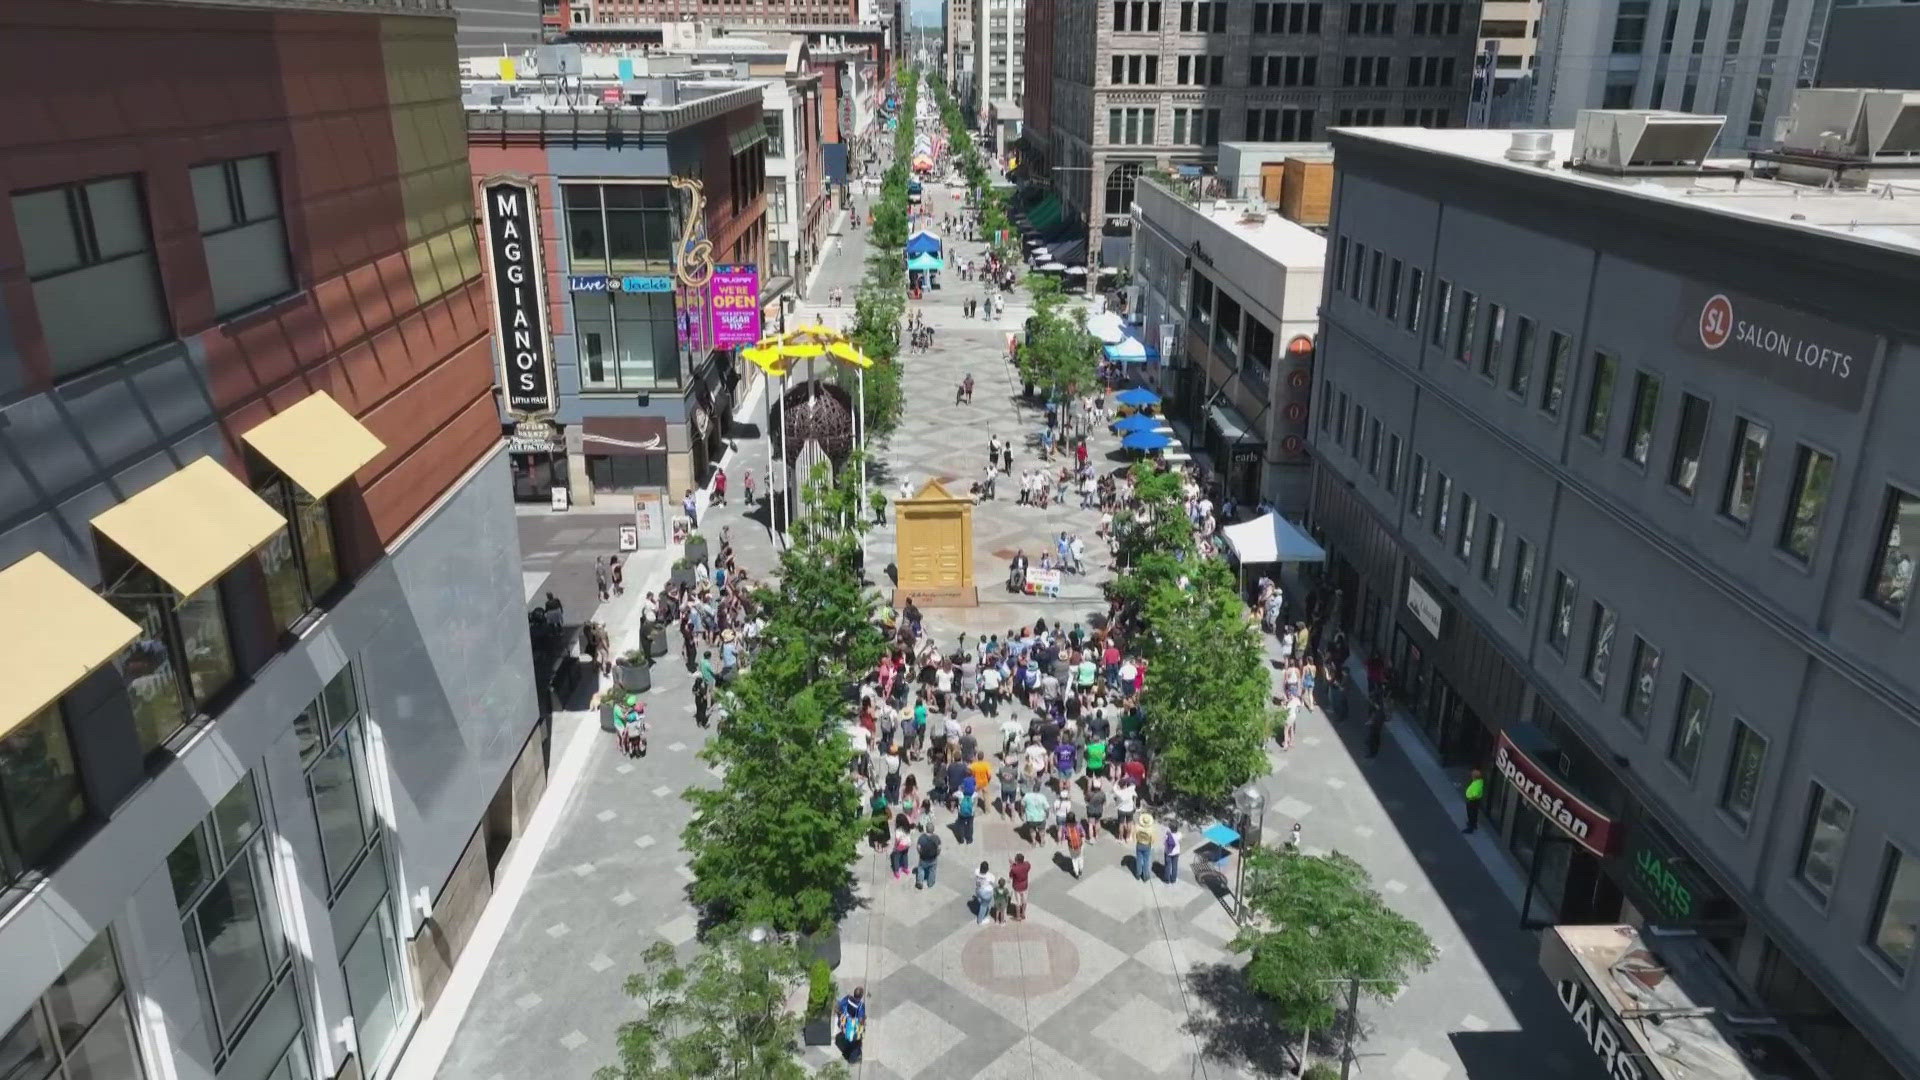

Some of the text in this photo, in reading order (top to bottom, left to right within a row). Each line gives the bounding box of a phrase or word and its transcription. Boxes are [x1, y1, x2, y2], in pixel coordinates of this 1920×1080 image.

[497, 193, 538, 391] MAGGIANO'S
[572, 277, 605, 290] Live
[609, 280, 621, 290] @
[718, 286, 749, 295] WE'RE
[713, 295, 756, 308] OPEN
[1736, 320, 1791, 357] SALON
[1795, 340, 1853, 378] LOFTS
[1235, 451, 1258, 462] earls
[1495, 748, 1588, 839] Sportsfan
[1637, 849, 1691, 915] JARS
